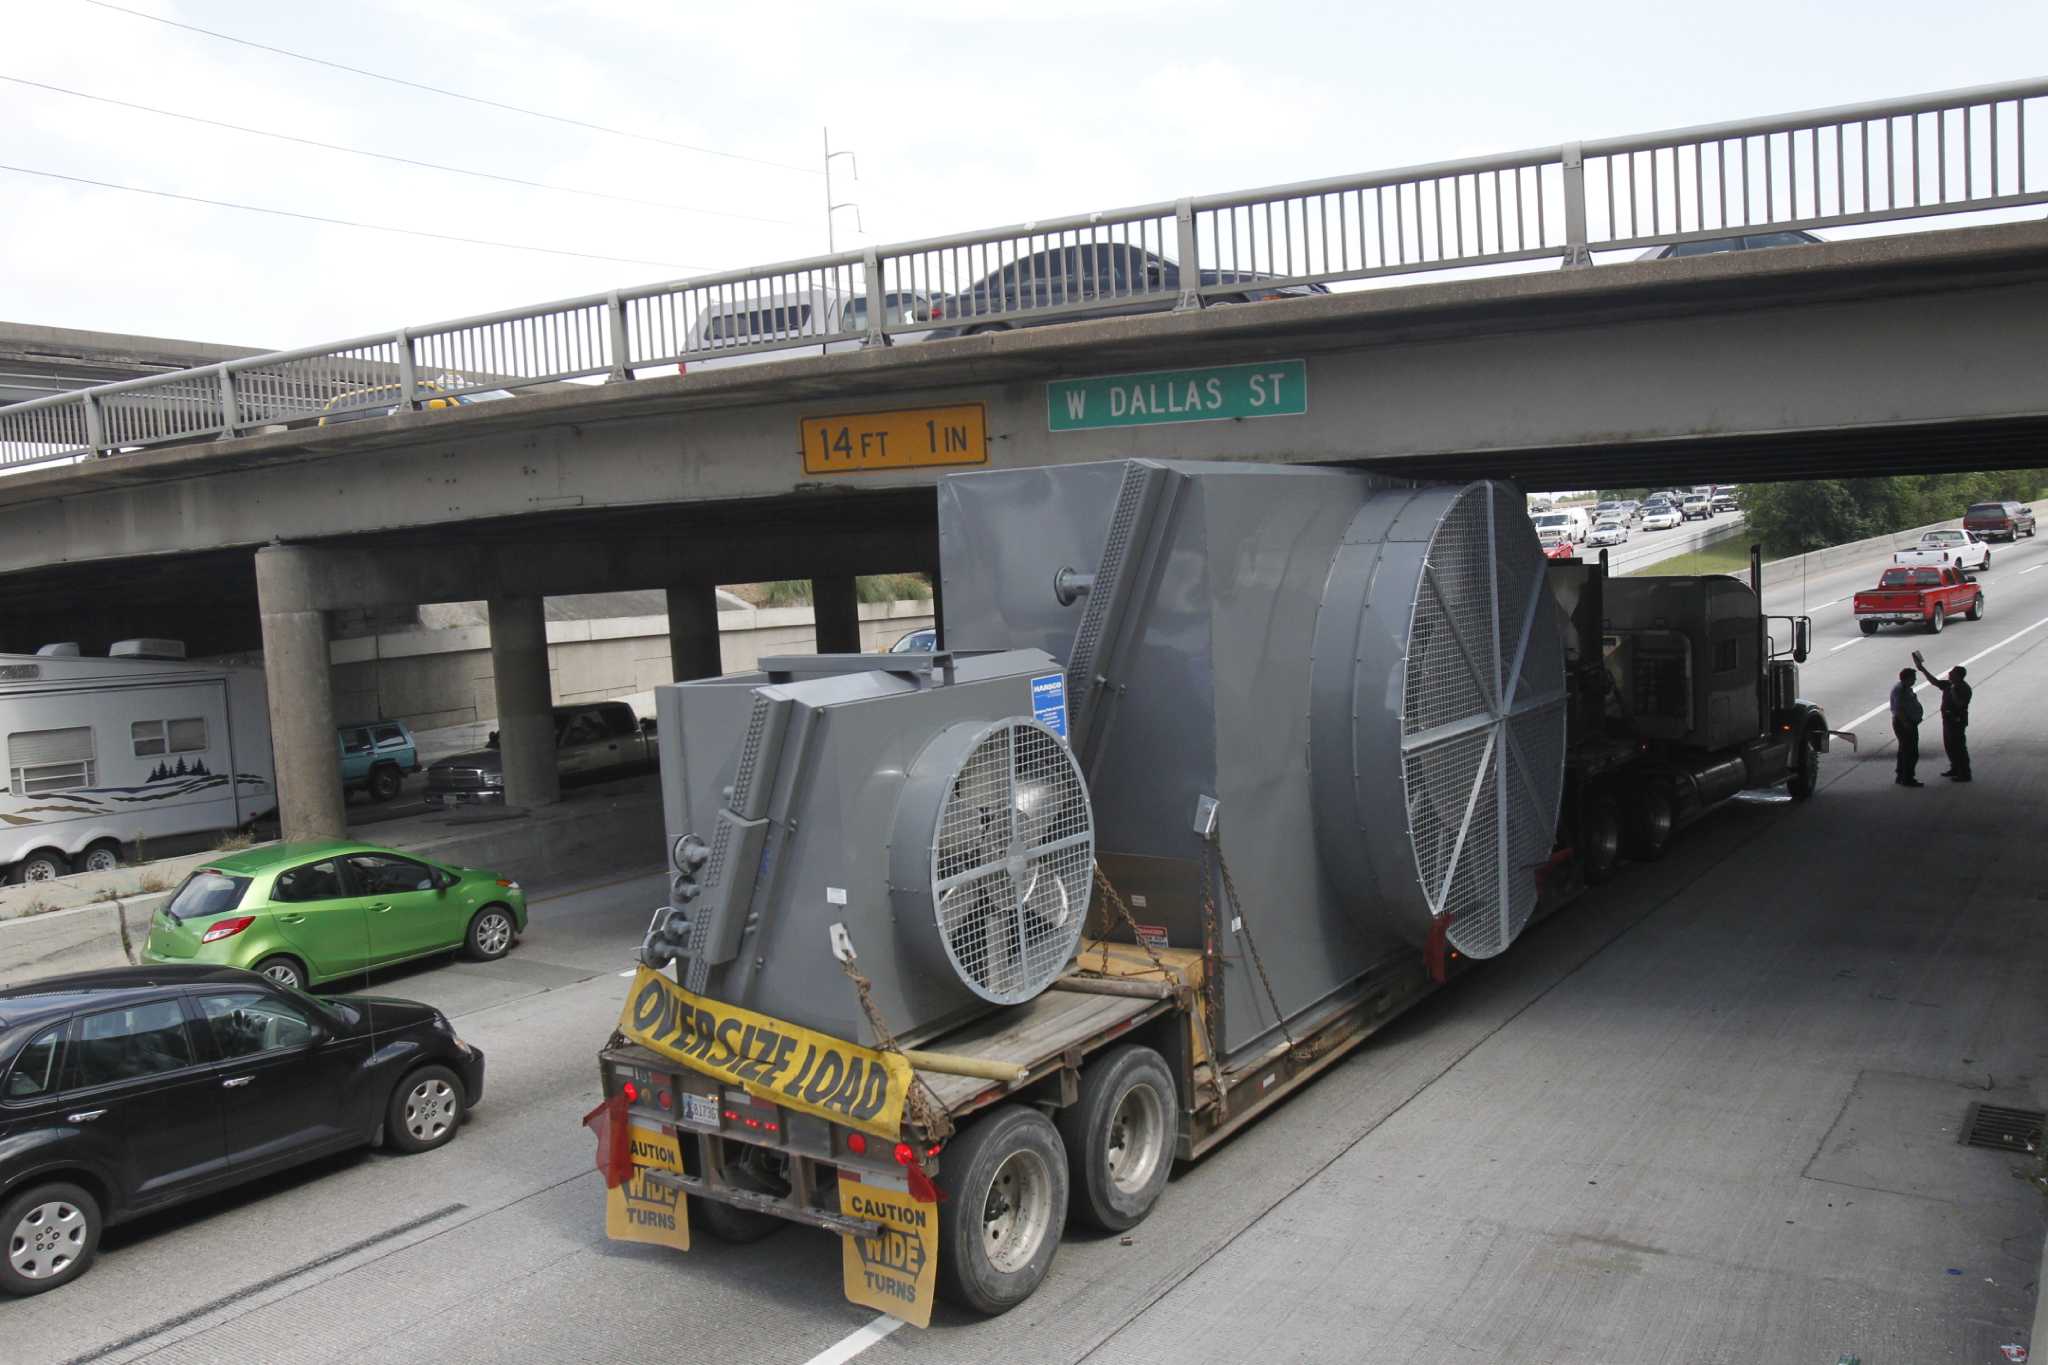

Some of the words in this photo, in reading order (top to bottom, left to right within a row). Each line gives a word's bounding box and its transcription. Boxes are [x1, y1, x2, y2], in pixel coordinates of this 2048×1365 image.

[1066, 389, 1086, 420] W
[1110, 378, 1223, 418] DALLAS
[1249, 373, 1285, 407] ST
[819, 426, 852, 461] 14
[861, 431, 888, 458] FT
[926, 419, 937, 454] 1
[944, 425, 968, 453] IN
[633, 978, 798, 1086] OVERSIZE
[785, 1044, 889, 1122] LOAD
[630, 1140, 676, 1165] AUTION
[626, 1207, 676, 1230] TURNS
[852, 1196, 926, 1228] CAUTION
[864, 1270, 917, 1303] TURNS
